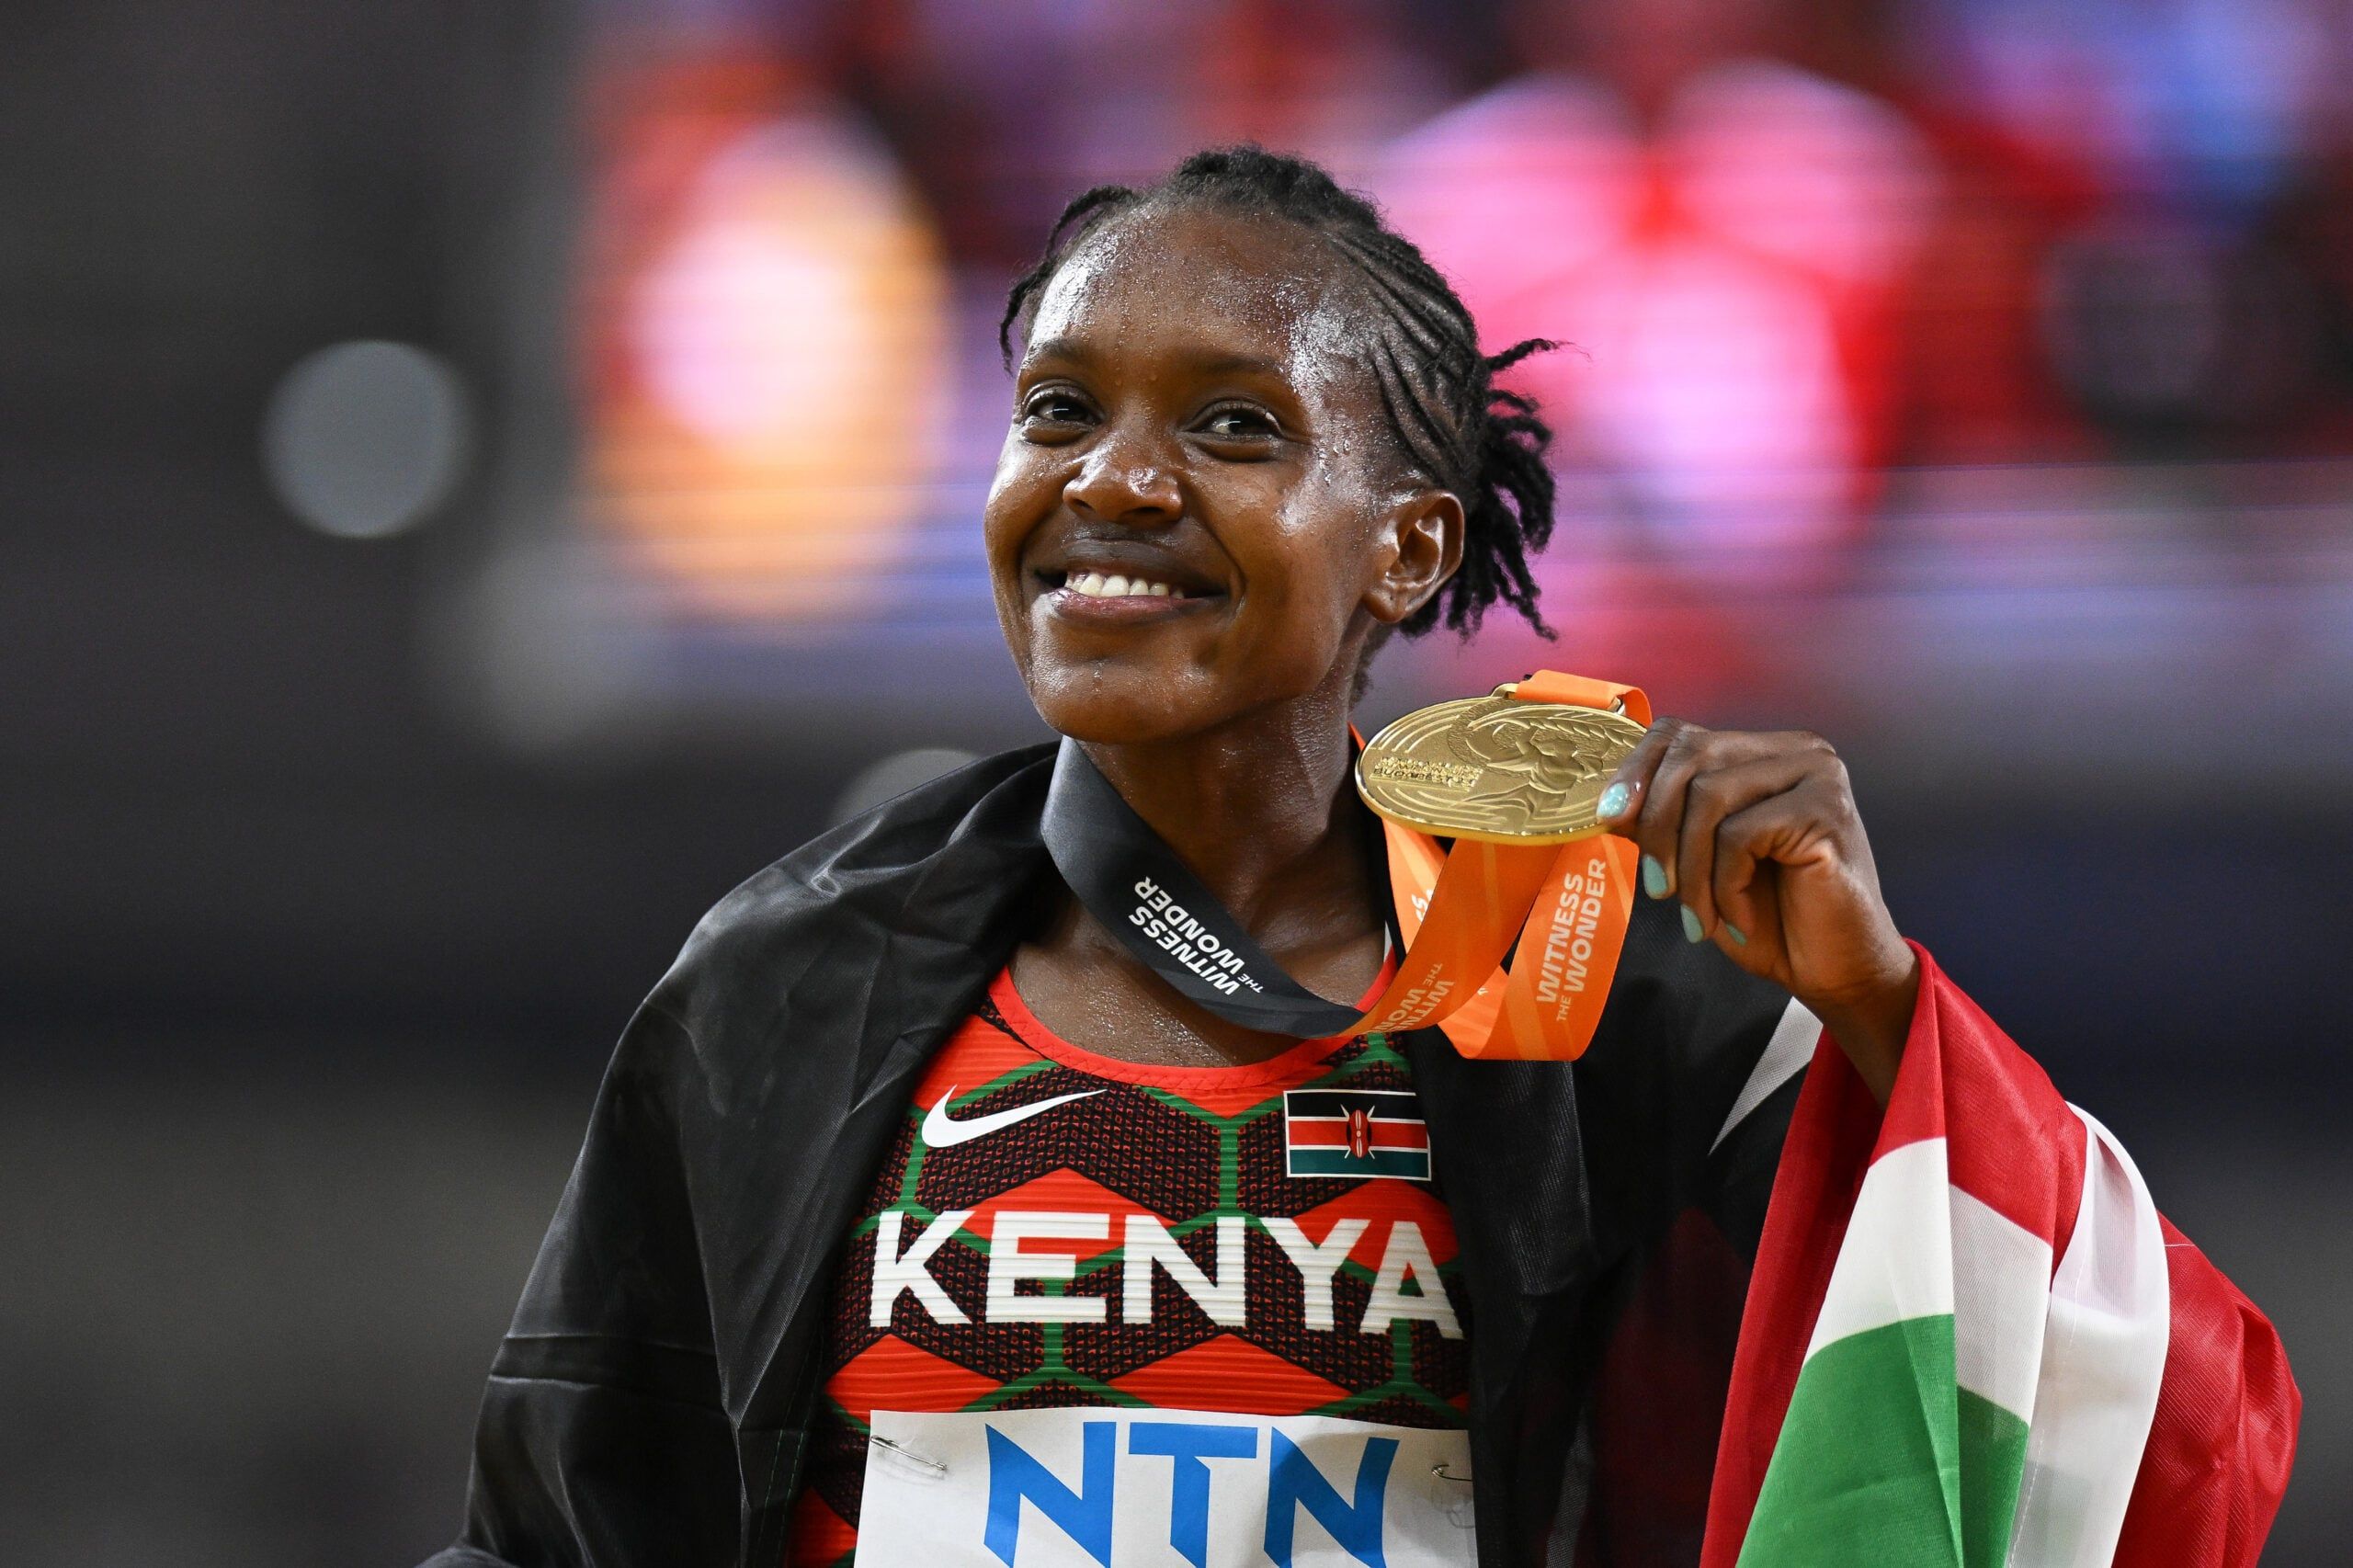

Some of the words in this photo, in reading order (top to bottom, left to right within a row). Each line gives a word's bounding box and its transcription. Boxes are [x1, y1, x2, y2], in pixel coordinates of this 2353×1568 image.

[1128, 906, 1241, 995] WITNESS
[1134, 876, 1245, 975] WONDER
[1537, 872, 1583, 1003] WITNESS
[1564, 858, 1607, 993] WONDER
[1237, 973, 1264, 994] THE
[1373, 989, 1427, 1030] WON
[1387, 980, 1455, 1031] WITNE
[1422, 963, 1443, 987] THE
[1556, 995, 1573, 1022] THE
[869, 1210, 1464, 1340] KENYA
[983, 1420, 1401, 1568] NTN
